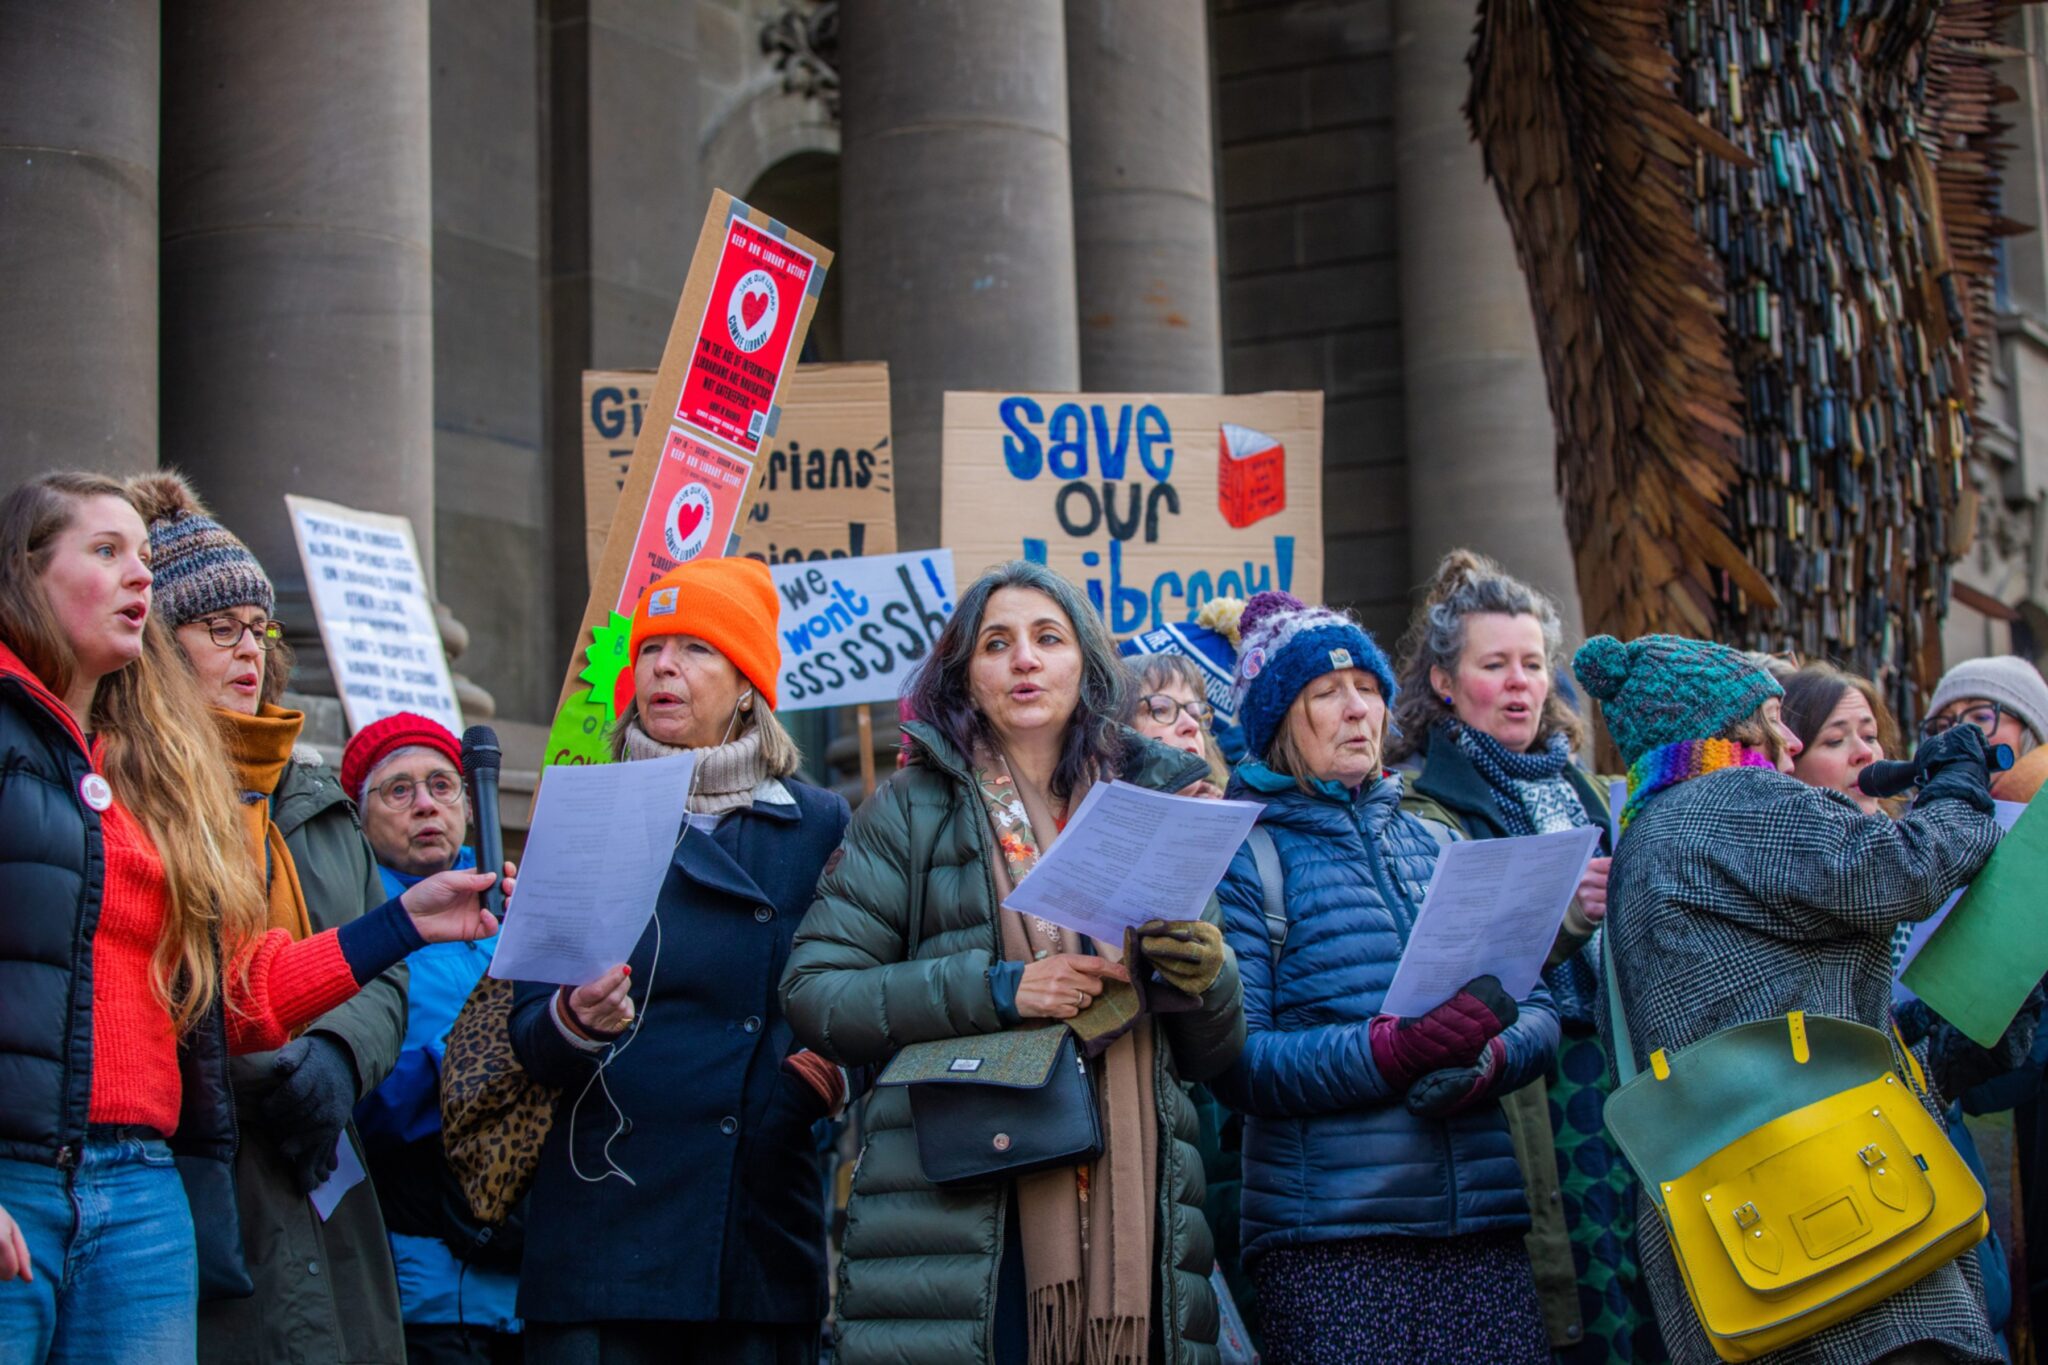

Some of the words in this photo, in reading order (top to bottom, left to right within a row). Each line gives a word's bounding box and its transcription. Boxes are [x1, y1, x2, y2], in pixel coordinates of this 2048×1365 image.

[732, 233, 746, 248] KEEP
[748, 242, 761, 256] OUR
[762, 250, 786, 269] LIBRARY
[787, 263, 806, 280] ACTIVE
[739, 277, 752, 294] SAVE
[754, 274, 765, 282] OUR
[728, 315, 744, 348] COMRIE
[744, 330, 767, 351] LIBRARY
[712, 342, 722, 358] THE
[723, 349, 734, 364] AGE
[734, 355, 741, 367] OF
[695, 356, 729, 379] LIBRARIANS
[729, 371, 740, 385] ARE
[740, 376, 771, 400] NAVIGATORS
[703, 376, 716, 390] NOT
[591, 387, 648, 438] Gi
[999, 396, 1174, 482] Save
[671, 448, 685, 461] KEEP
[686, 455, 698, 468] OUR
[700, 460, 721, 478] LIBRARY
[722, 472, 741, 488] ACTIVE
[760, 441, 876, 490] rians
[690, 486, 701, 494] OUR
[1055, 481, 1180, 543] our
[666, 527, 680, 558] COMRIE
[680, 540, 702, 560] LIBRARY
[783, 579, 869, 656] won't
[1144, 628, 1172, 650] THE
